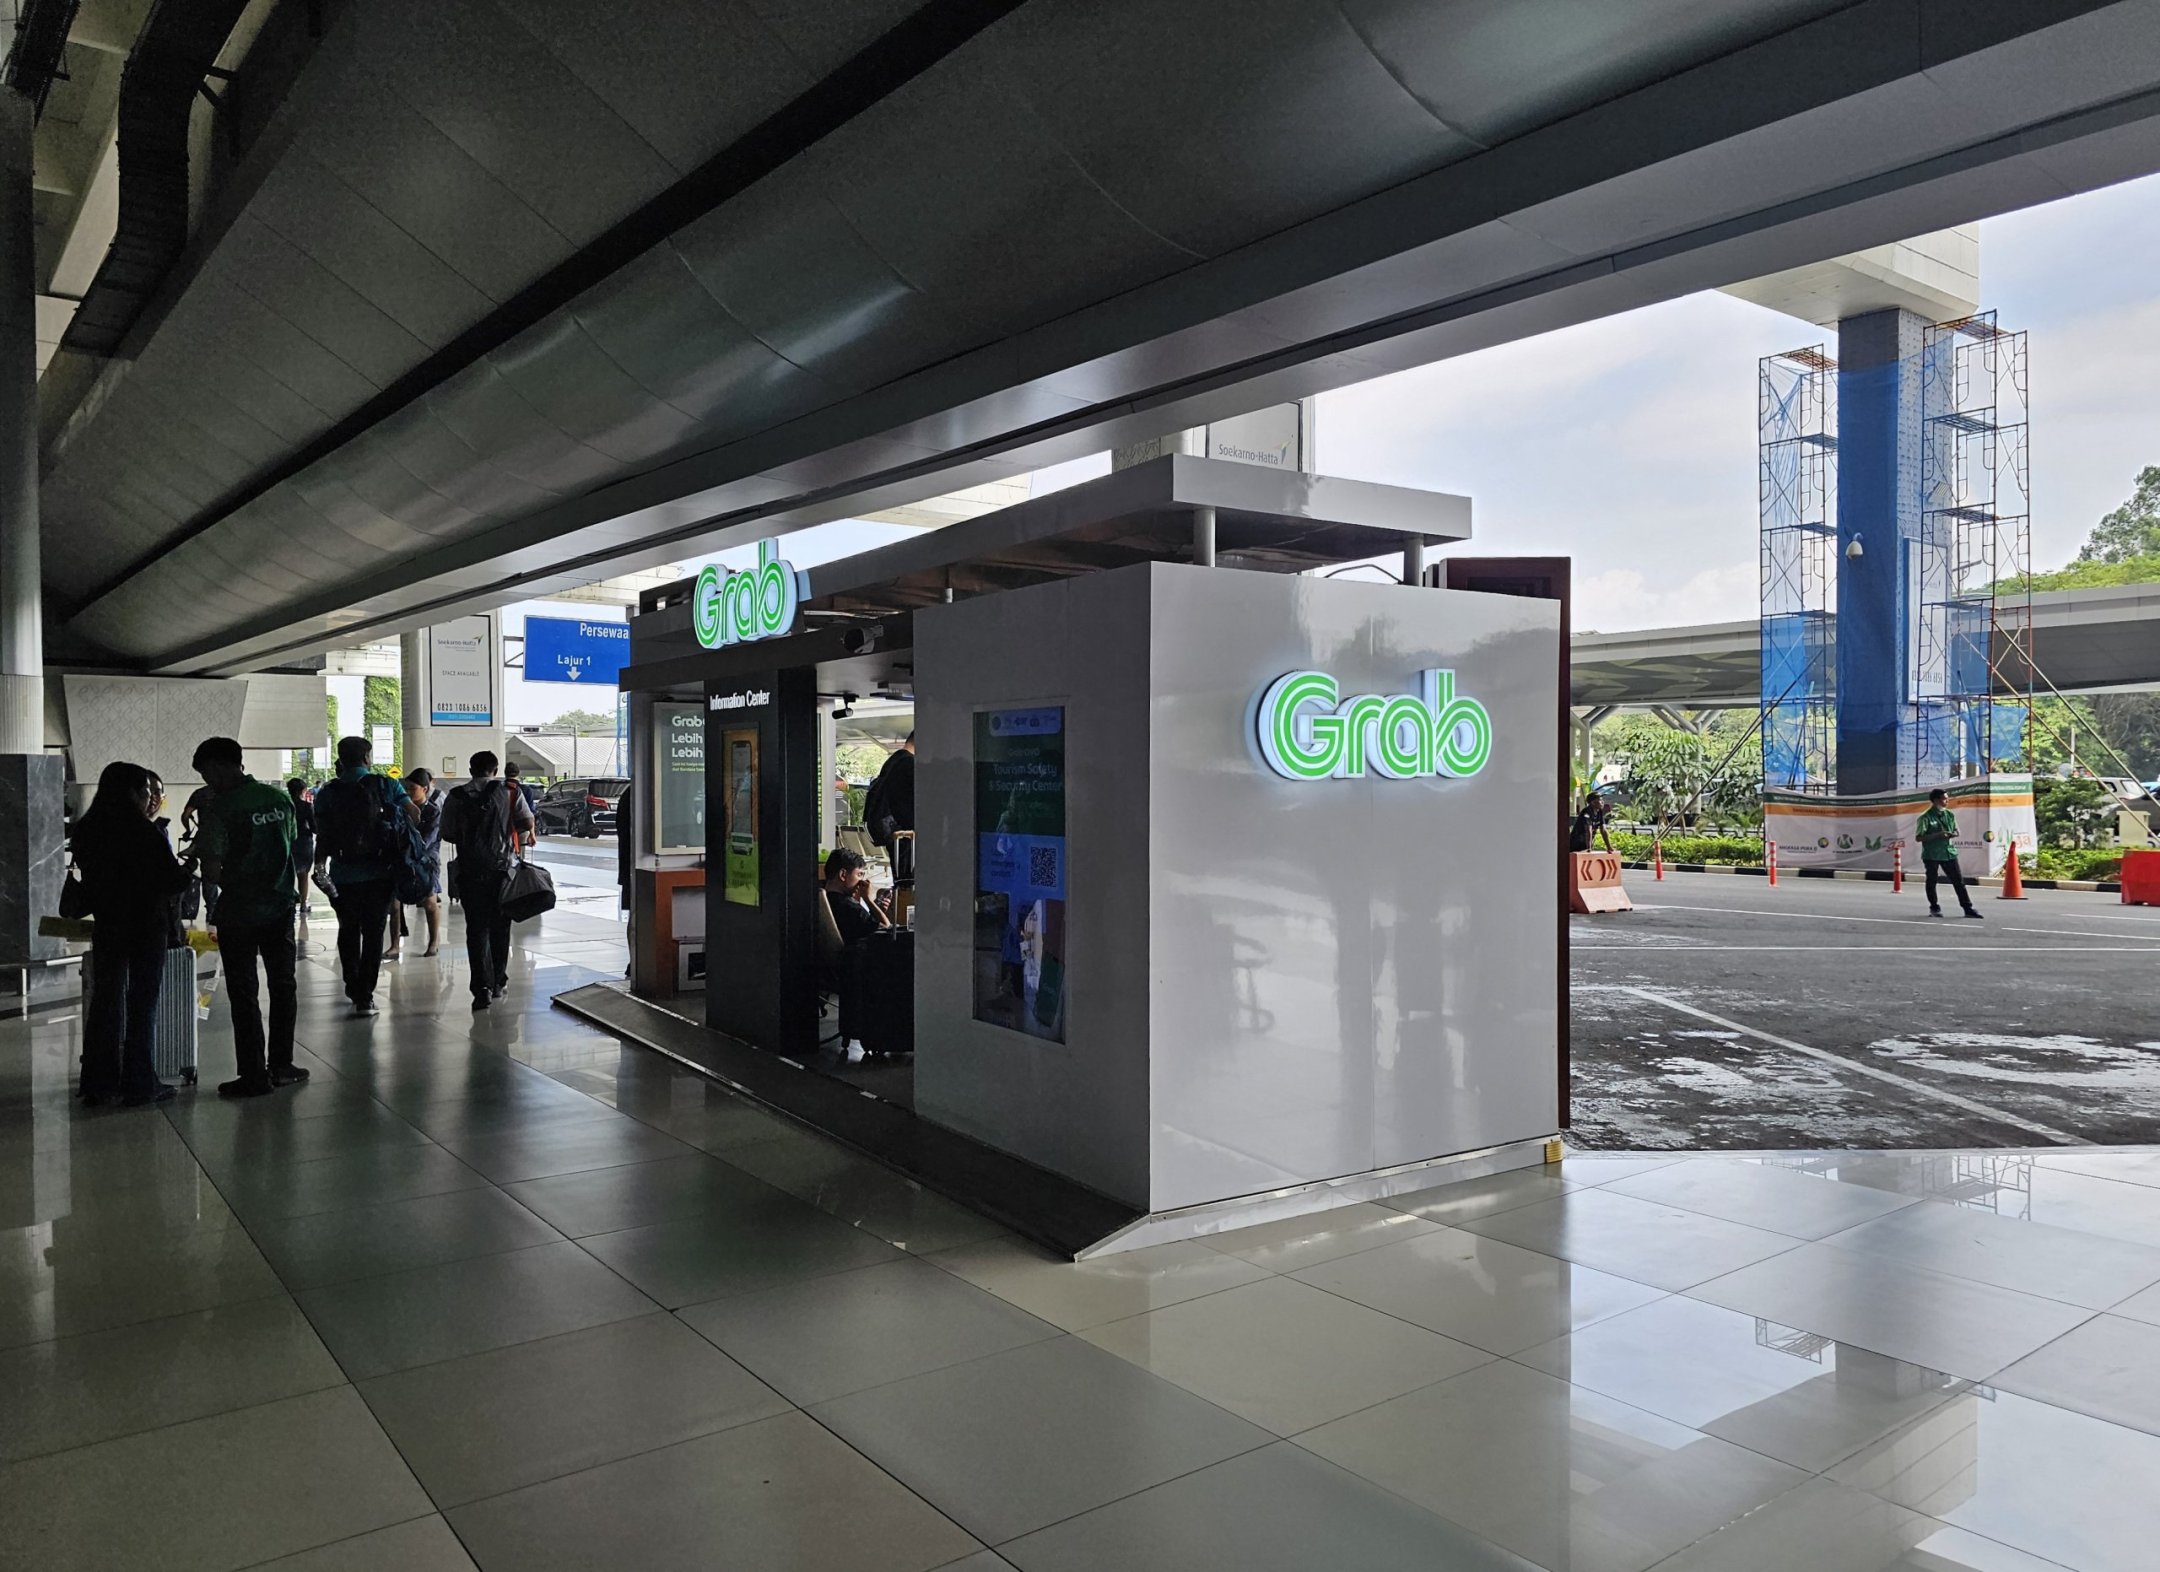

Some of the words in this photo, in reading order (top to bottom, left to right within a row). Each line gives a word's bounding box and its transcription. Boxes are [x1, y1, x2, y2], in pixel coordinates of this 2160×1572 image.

[693, 537, 797, 650] Grab
[580, 622, 629, 639] Persewaa
[557, 654, 584, 667] Lajur
[586, 655, 591, 666] 1
[437, 702, 453, 712] 0823
[709, 691, 745, 711] Information
[746, 689, 770, 707] Center
[671, 715, 705, 727] Grab
[1255, 668, 1493, 781] Grab
[671, 733, 703, 743] Lebih
[671, 747, 703, 758] Lebih
[1027, 762, 1058, 777] Safety
[995, 781, 1031, 794] Security
[1032, 780, 1062, 791] Center
[252, 808, 285, 825] Grab
